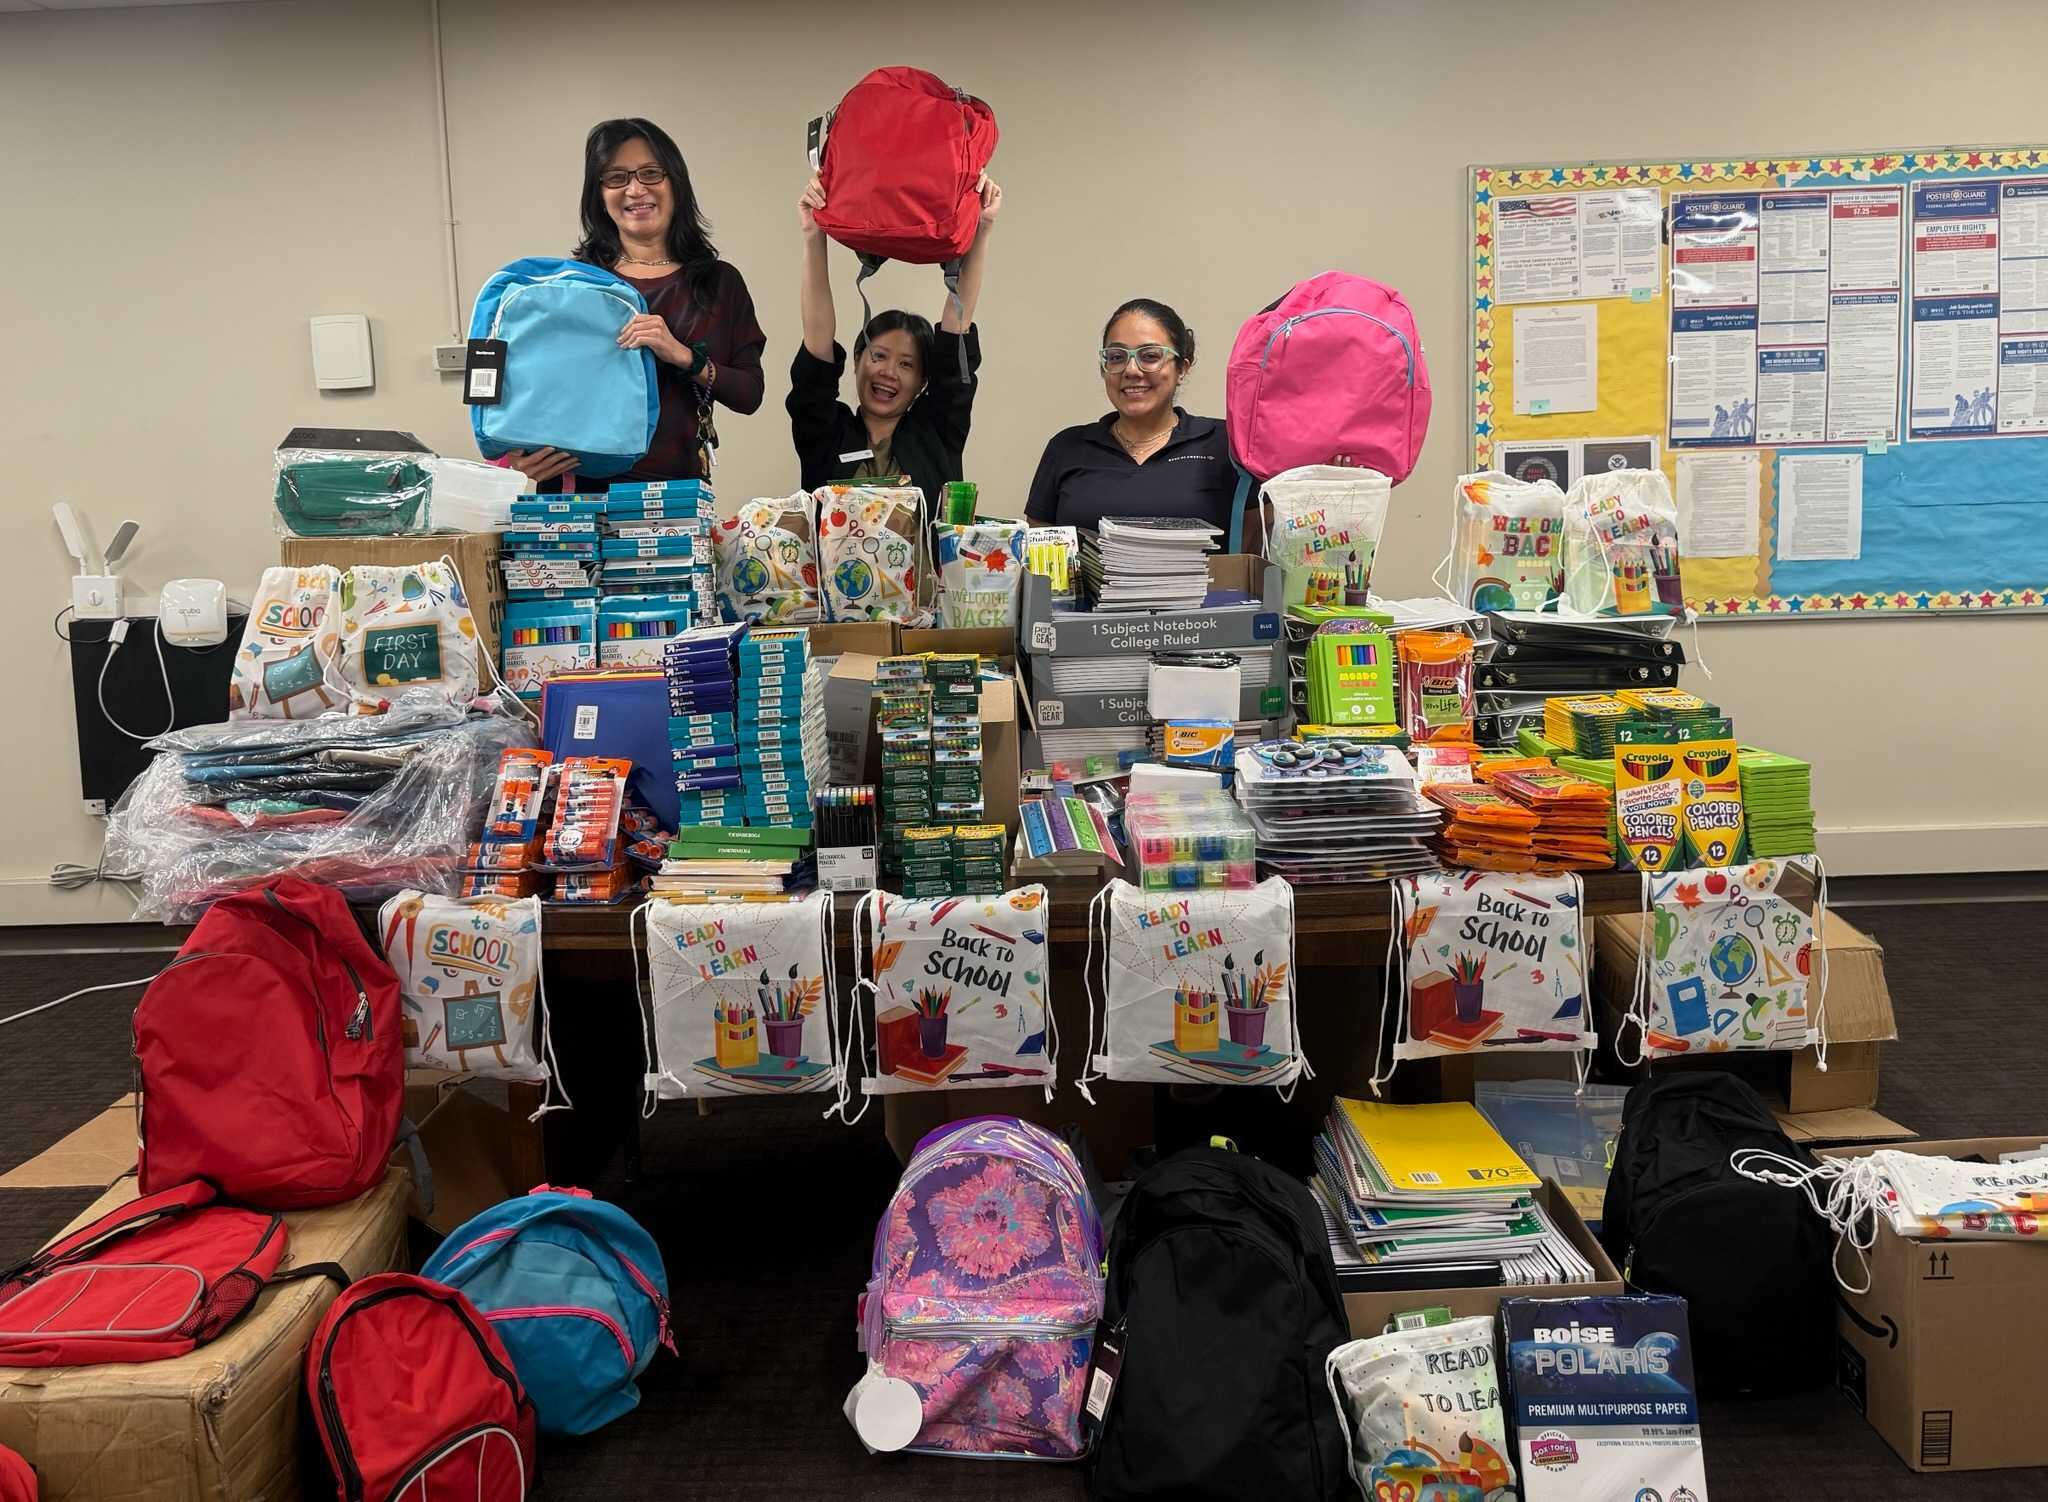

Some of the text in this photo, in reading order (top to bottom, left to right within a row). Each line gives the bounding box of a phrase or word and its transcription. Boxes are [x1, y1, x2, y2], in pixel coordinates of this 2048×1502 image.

[1926, 192, 1951, 200] POSTER
[1685, 203, 1710, 212] POSTER
[1926, 223, 1986, 233] EMPLOYEE RIGHTS
[1286, 508, 1326, 531] READY
[1609, 509, 1625, 523] TO
[1312, 524, 1327, 537] TO
[1600, 513, 1650, 544] LEARN
[1304, 530, 1350, 556] LEARN
[951, 588, 1009, 604] WELCOME
[178, 607, 200, 615] aruba
[951, 606, 1008, 628] BACK
[1092, 619, 1217, 637] 1 Subject Notebook
[374, 632, 429, 653] FIRST
[1110, 632, 1200, 649] College Ruled
[383, 651, 422, 670] DAY
[1099, 699, 1105, 710] 1
[1440, 698, 1460, 712] Life
[1042, 711, 1063, 723] GEAR
[1620, 730, 1632, 742] 12
[1678, 728, 1690, 740] 12
[1625, 752, 1669, 763] Crayola
[1687, 748, 1728, 760] Crayola
[1647, 782, 1670, 793] YOUR
[1620, 788, 1680, 806] Favorite Color?
[1628, 804, 1646, 813] VOTE
[1685, 802, 1740, 818] COLORED
[1623, 814, 1677, 827] COLORED
[1690, 814, 1739, 831] PENCILS
[1627, 825, 1674, 839] PENCILS
[1644, 850, 1658, 862] 12
[1711, 845, 1724, 857] 12
[1138, 899, 1189, 930] READY
[471, 915, 489, 930] to
[1169, 920, 1190, 937] TO
[674, 918, 725, 951] READY
[432, 929, 511, 970] SCHOOL
[706, 939, 726, 957] TO
[1163, 927, 1223, 961] LEARN
[698, 944, 758, 982] LEARN
[1530, 969, 1545, 984] 3
[993, 1003, 1008, 1019] 3
[1480, 1168, 1510, 1178] 70
[1535, 1347, 1670, 1376] POLARIS
[1419, 1393, 1453, 1413] TO
[1528, 1402, 1688, 1417] PREMIUM MULTIPURPOSE PAPER
[1540, 1431, 1566, 1441] OFFICIAL
[1533, 1447, 1548, 1457] BOX
